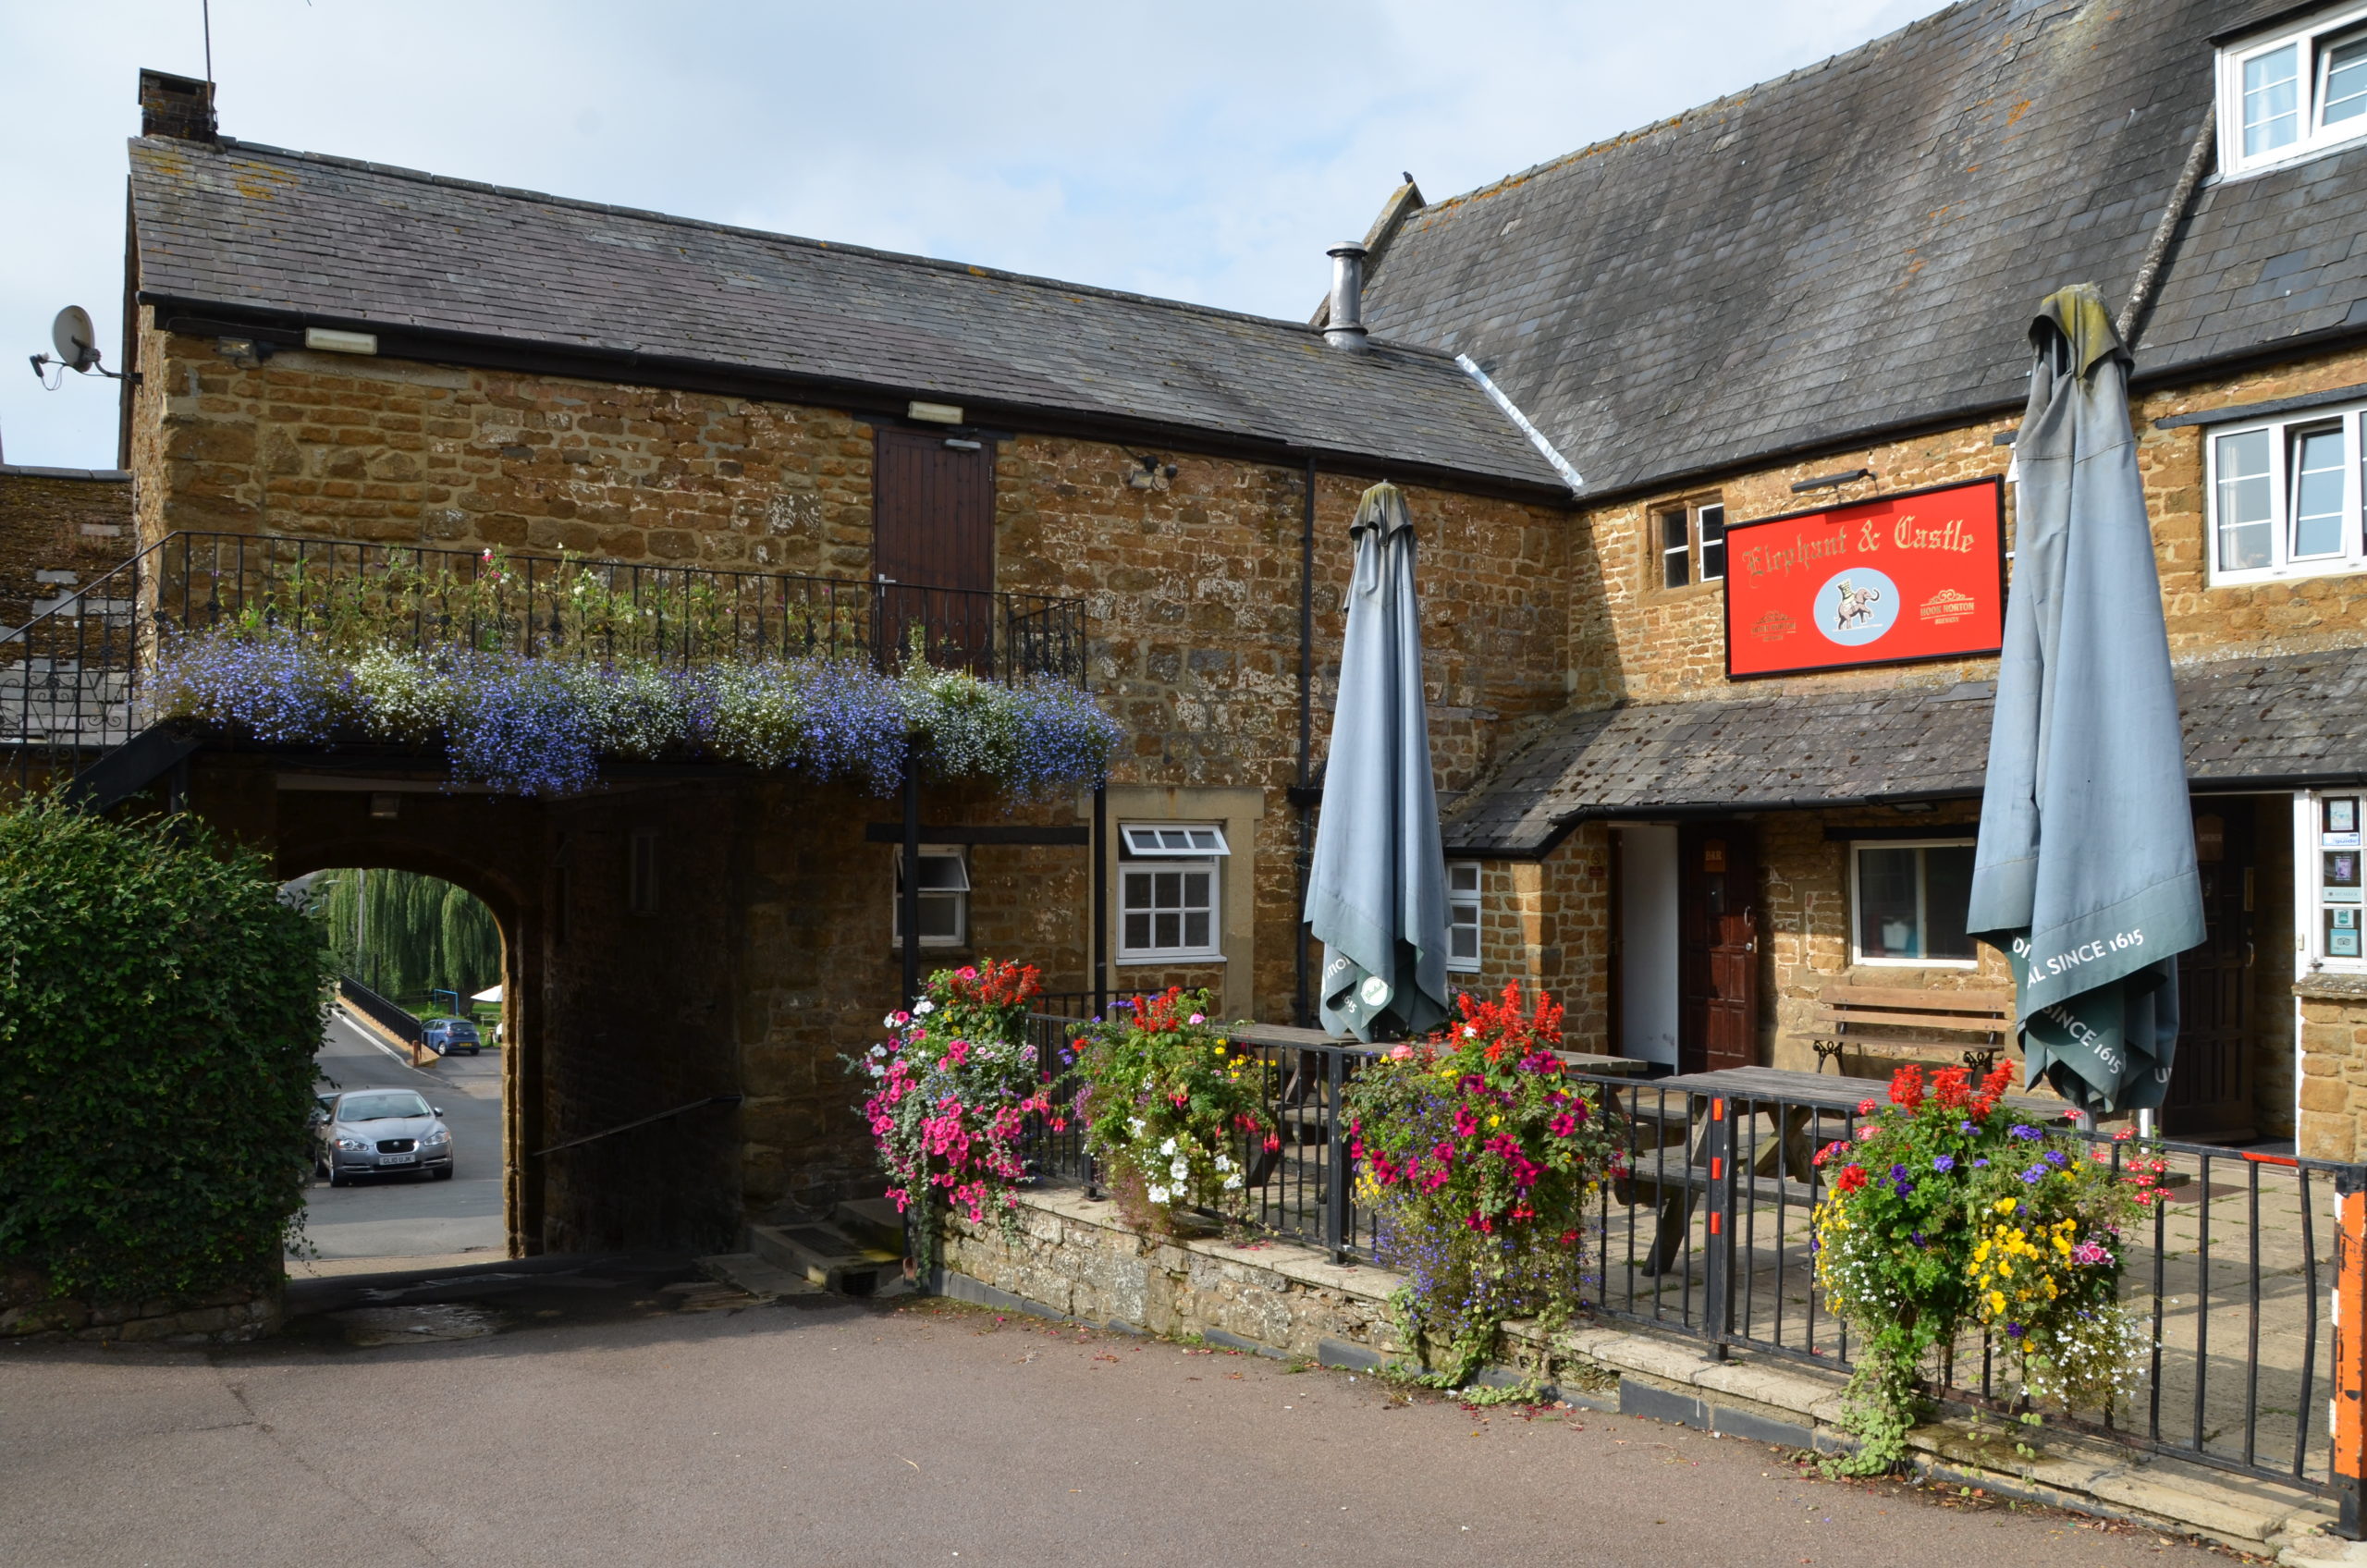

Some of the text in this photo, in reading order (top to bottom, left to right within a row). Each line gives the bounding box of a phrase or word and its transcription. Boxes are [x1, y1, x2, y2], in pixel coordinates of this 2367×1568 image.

[1742, 515, 1975, 589] Elephant & Castle
[1919, 602, 1974, 616] HOOK NORTON
[2046, 939, 2106, 974] SINCE
[2109, 929, 2144, 952] 1615
[2042, 1003, 2123, 1074] SINCE 1615
